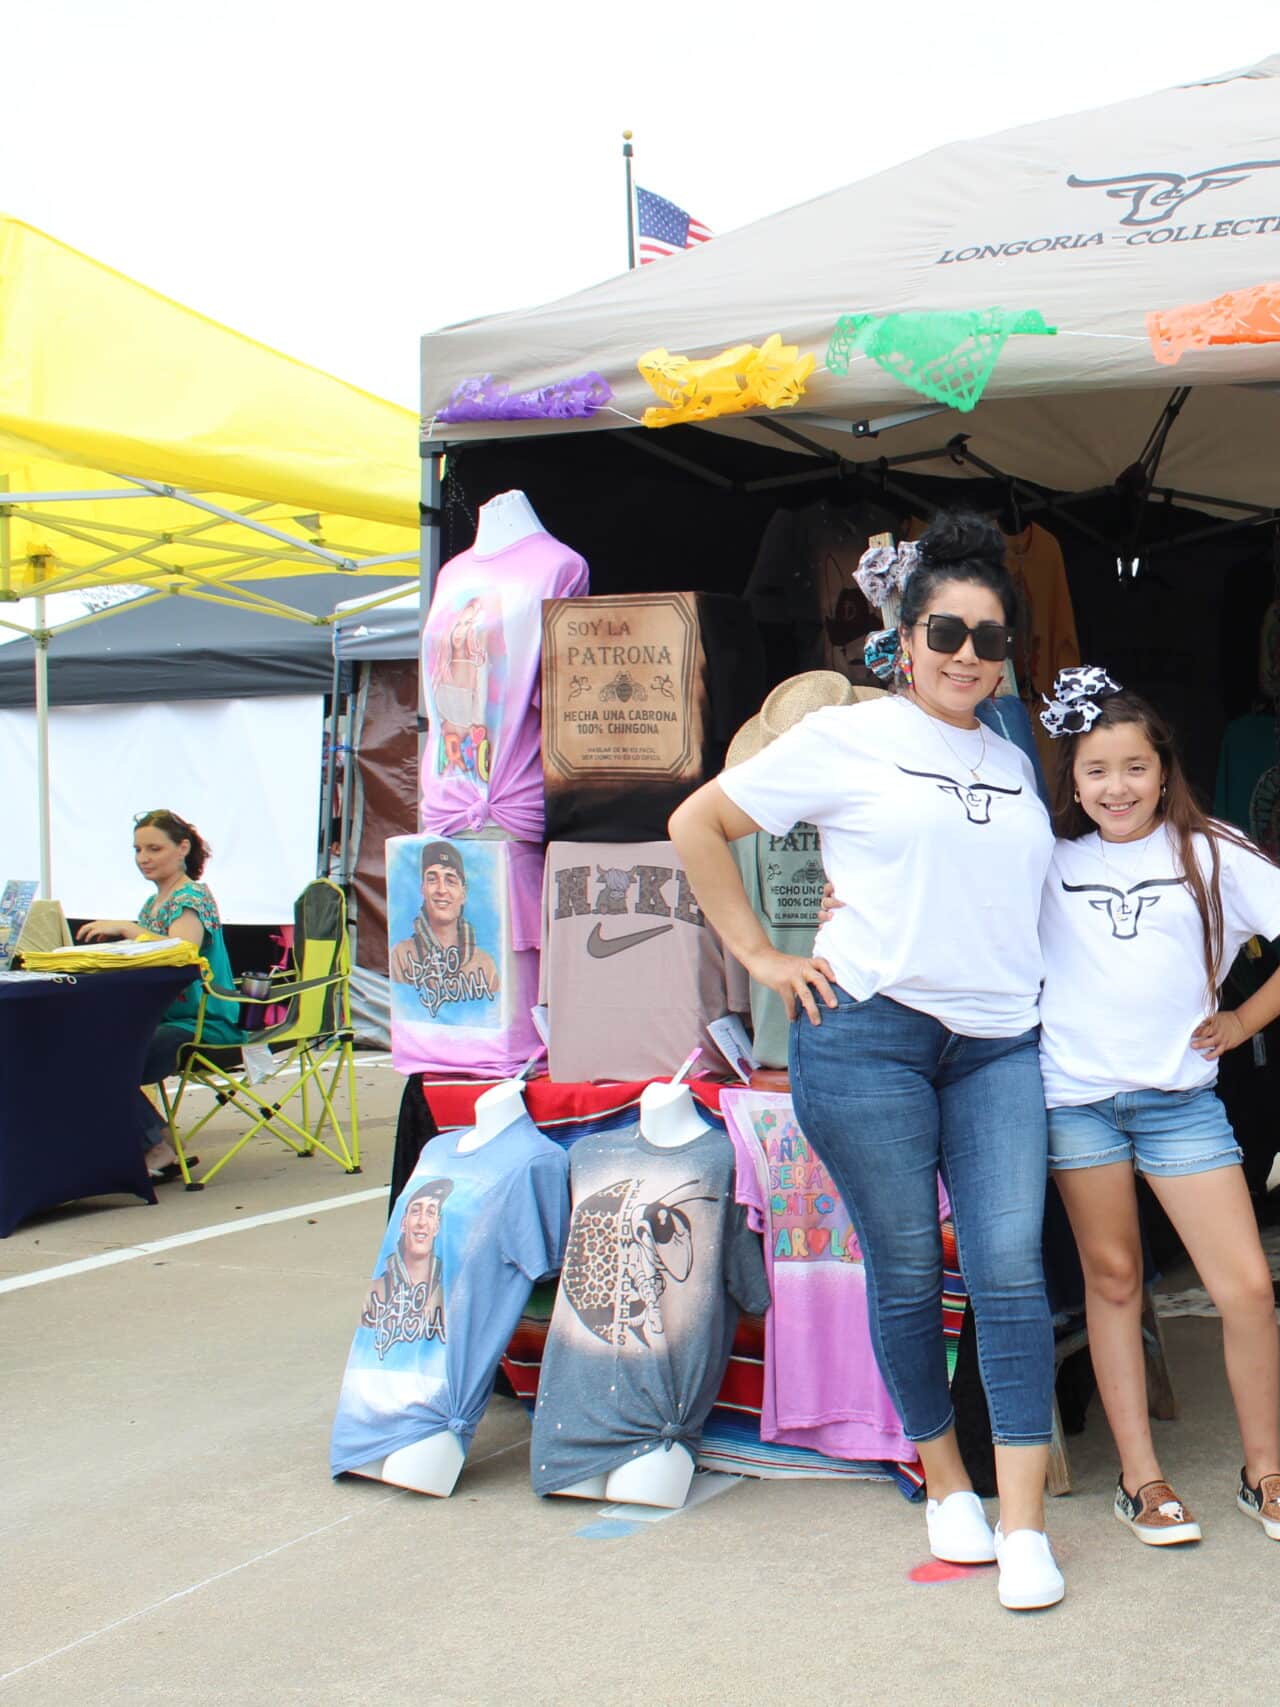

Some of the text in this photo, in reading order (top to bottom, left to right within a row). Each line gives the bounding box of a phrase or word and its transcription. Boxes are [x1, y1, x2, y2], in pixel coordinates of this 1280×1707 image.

[936, 231, 1104, 265] LONGORIA
[567, 619, 631, 636] SOY LA
[567, 645, 672, 666] PATRONA
[563, 710, 678, 722] HECHA UNA CABRONA
[576, 723, 659, 735] 100% CHINGONA
[617, 1253, 632, 1346] JACKETS
